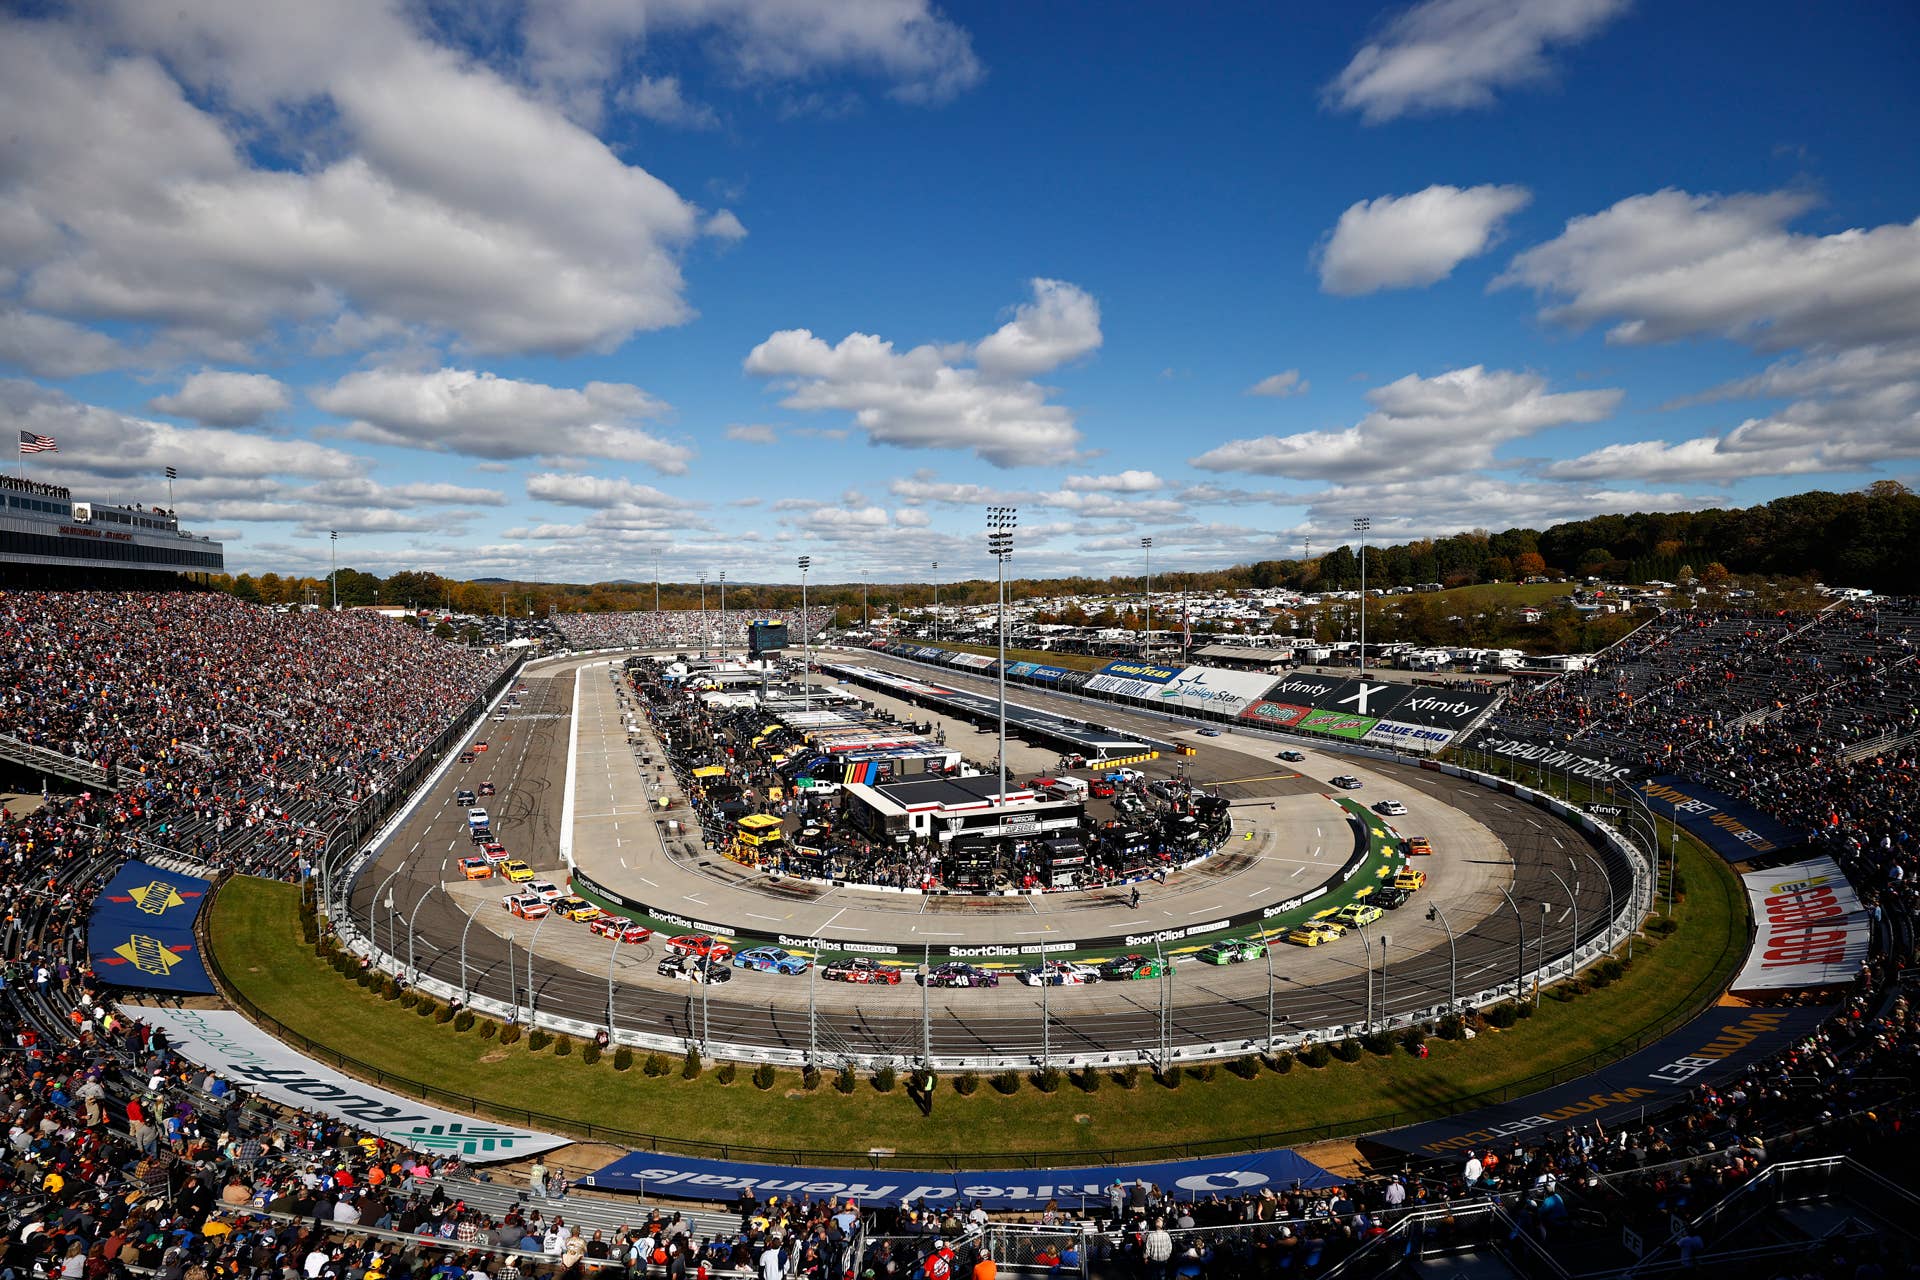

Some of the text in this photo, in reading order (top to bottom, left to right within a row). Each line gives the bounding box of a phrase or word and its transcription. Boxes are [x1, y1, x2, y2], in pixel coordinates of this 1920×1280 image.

[1110, 665, 1172, 678] GOODYEAR
[1113, 680, 1152, 698] VODKA
[1277, 681, 1333, 697] xfinity
[1404, 697, 1479, 717] xfinity
[1494, 740, 1551, 760] DEAD
[1590, 804, 1621, 816] xfinity
[139, 884, 172, 911] SUNOCO
[1264, 899, 1302, 918] SportClips
[1764, 886, 1849, 935] COOK
[649, 909, 692, 929] SportClips
[779, 935, 840, 951] SportClips
[949, 945, 1019, 956] SportClips
[1761, 930, 1848, 967] OUT
[135, 937, 165, 974] SUNOCO
[955, 975, 969, 986] 48
[1140, 966, 1151, 976] 42
[161, 1007, 268, 1066] MORTGAGE
[631, 1168, 900, 1200] Rentals
